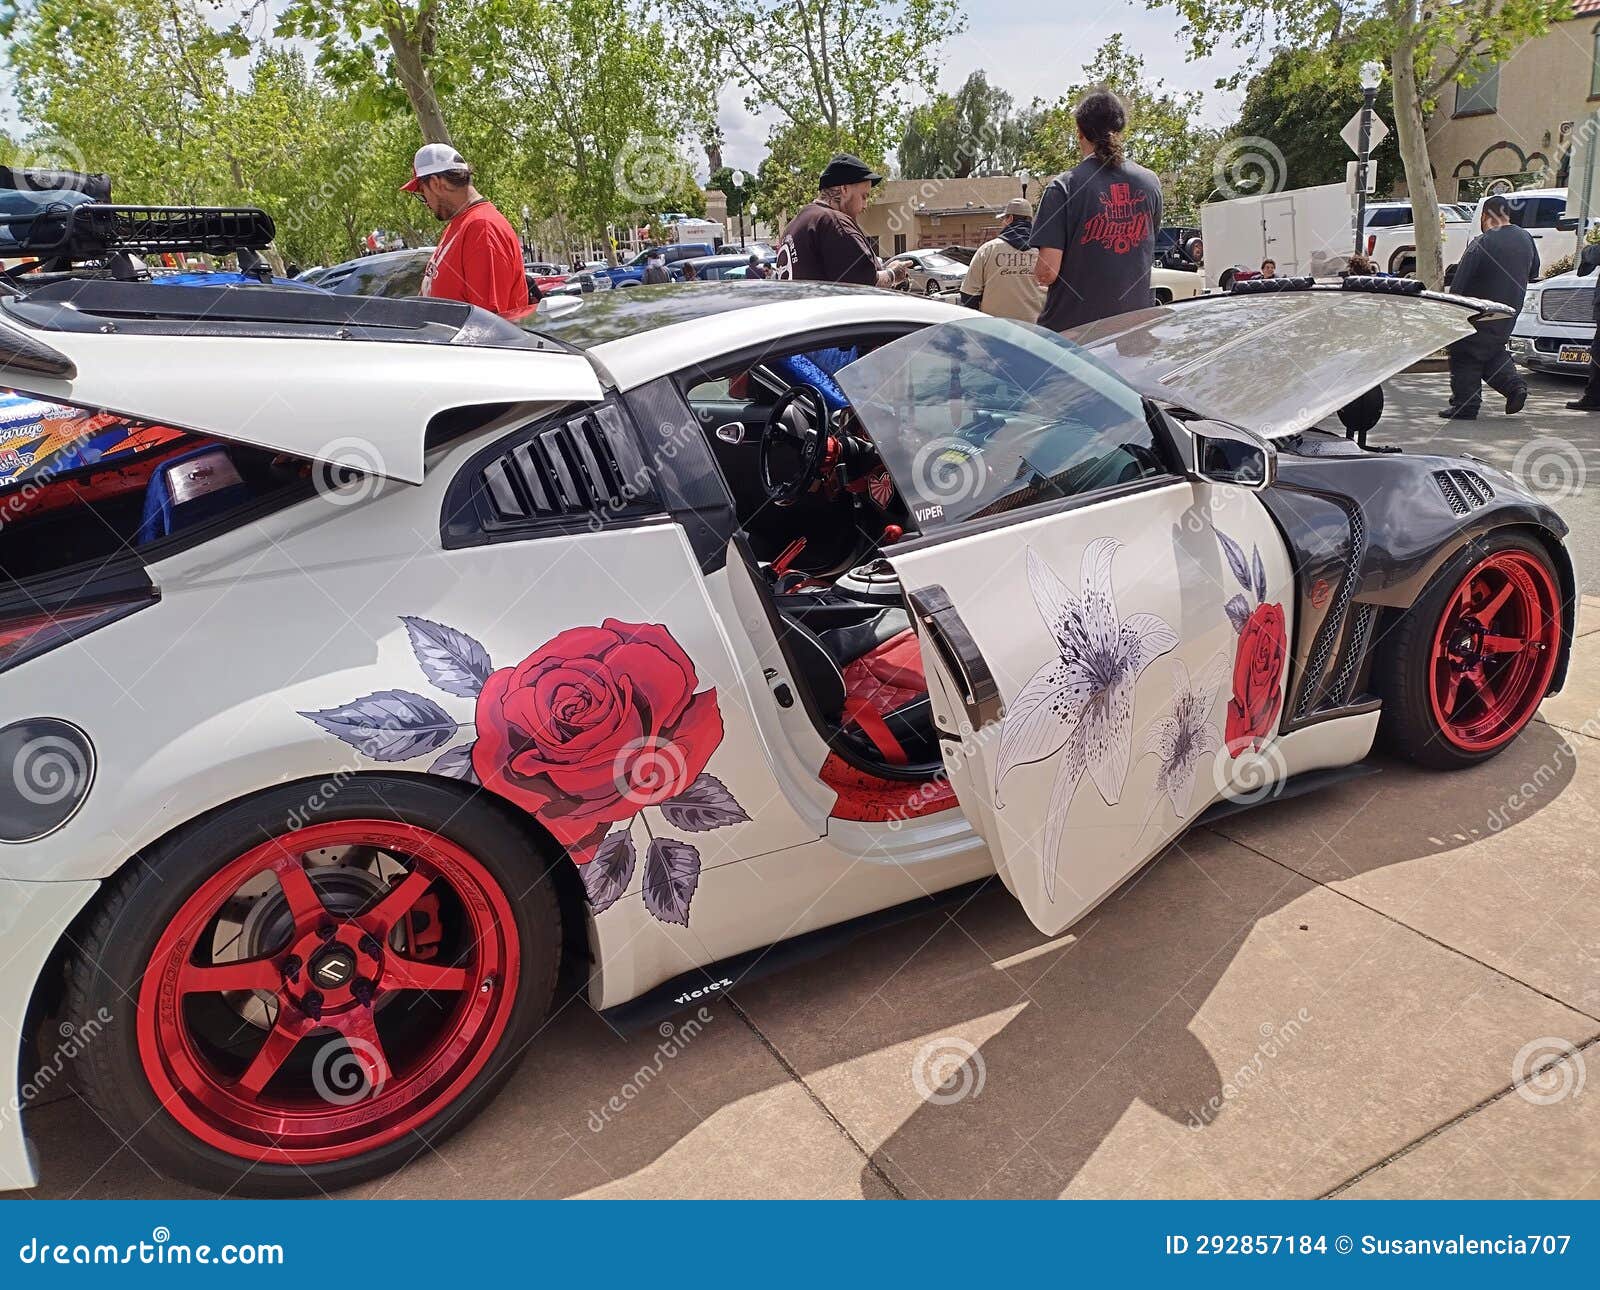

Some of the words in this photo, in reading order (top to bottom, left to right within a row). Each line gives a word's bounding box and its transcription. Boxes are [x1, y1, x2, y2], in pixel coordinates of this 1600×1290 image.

[0, 422, 44, 443] arage
[915, 505, 944, 522] VIPER
[674, 978, 733, 1004] vicrez
